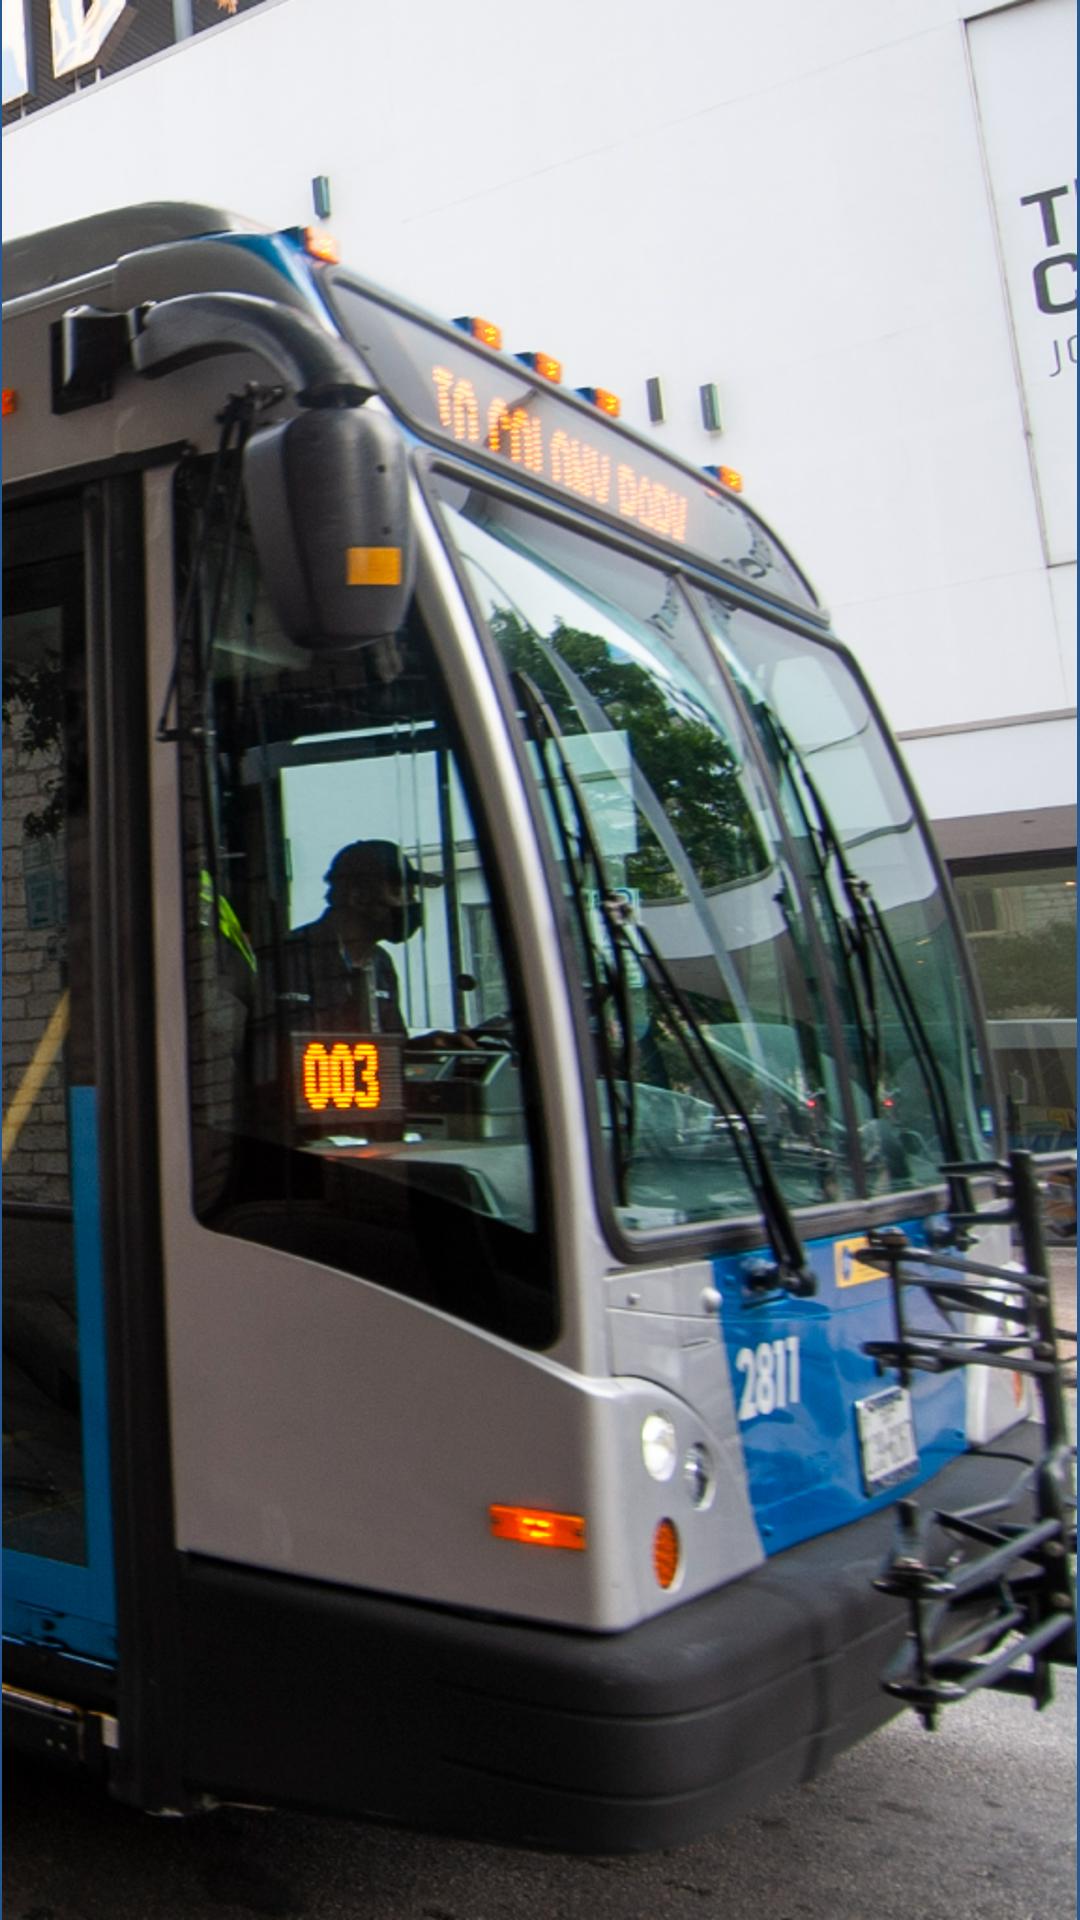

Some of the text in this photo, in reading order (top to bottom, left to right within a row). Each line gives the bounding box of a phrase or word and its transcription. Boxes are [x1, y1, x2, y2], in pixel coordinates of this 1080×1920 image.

[1020, 179, 1077, 247] T
[303, 1042, 380, 1110] 003
[735, 1336, 800, 1421] 2811
